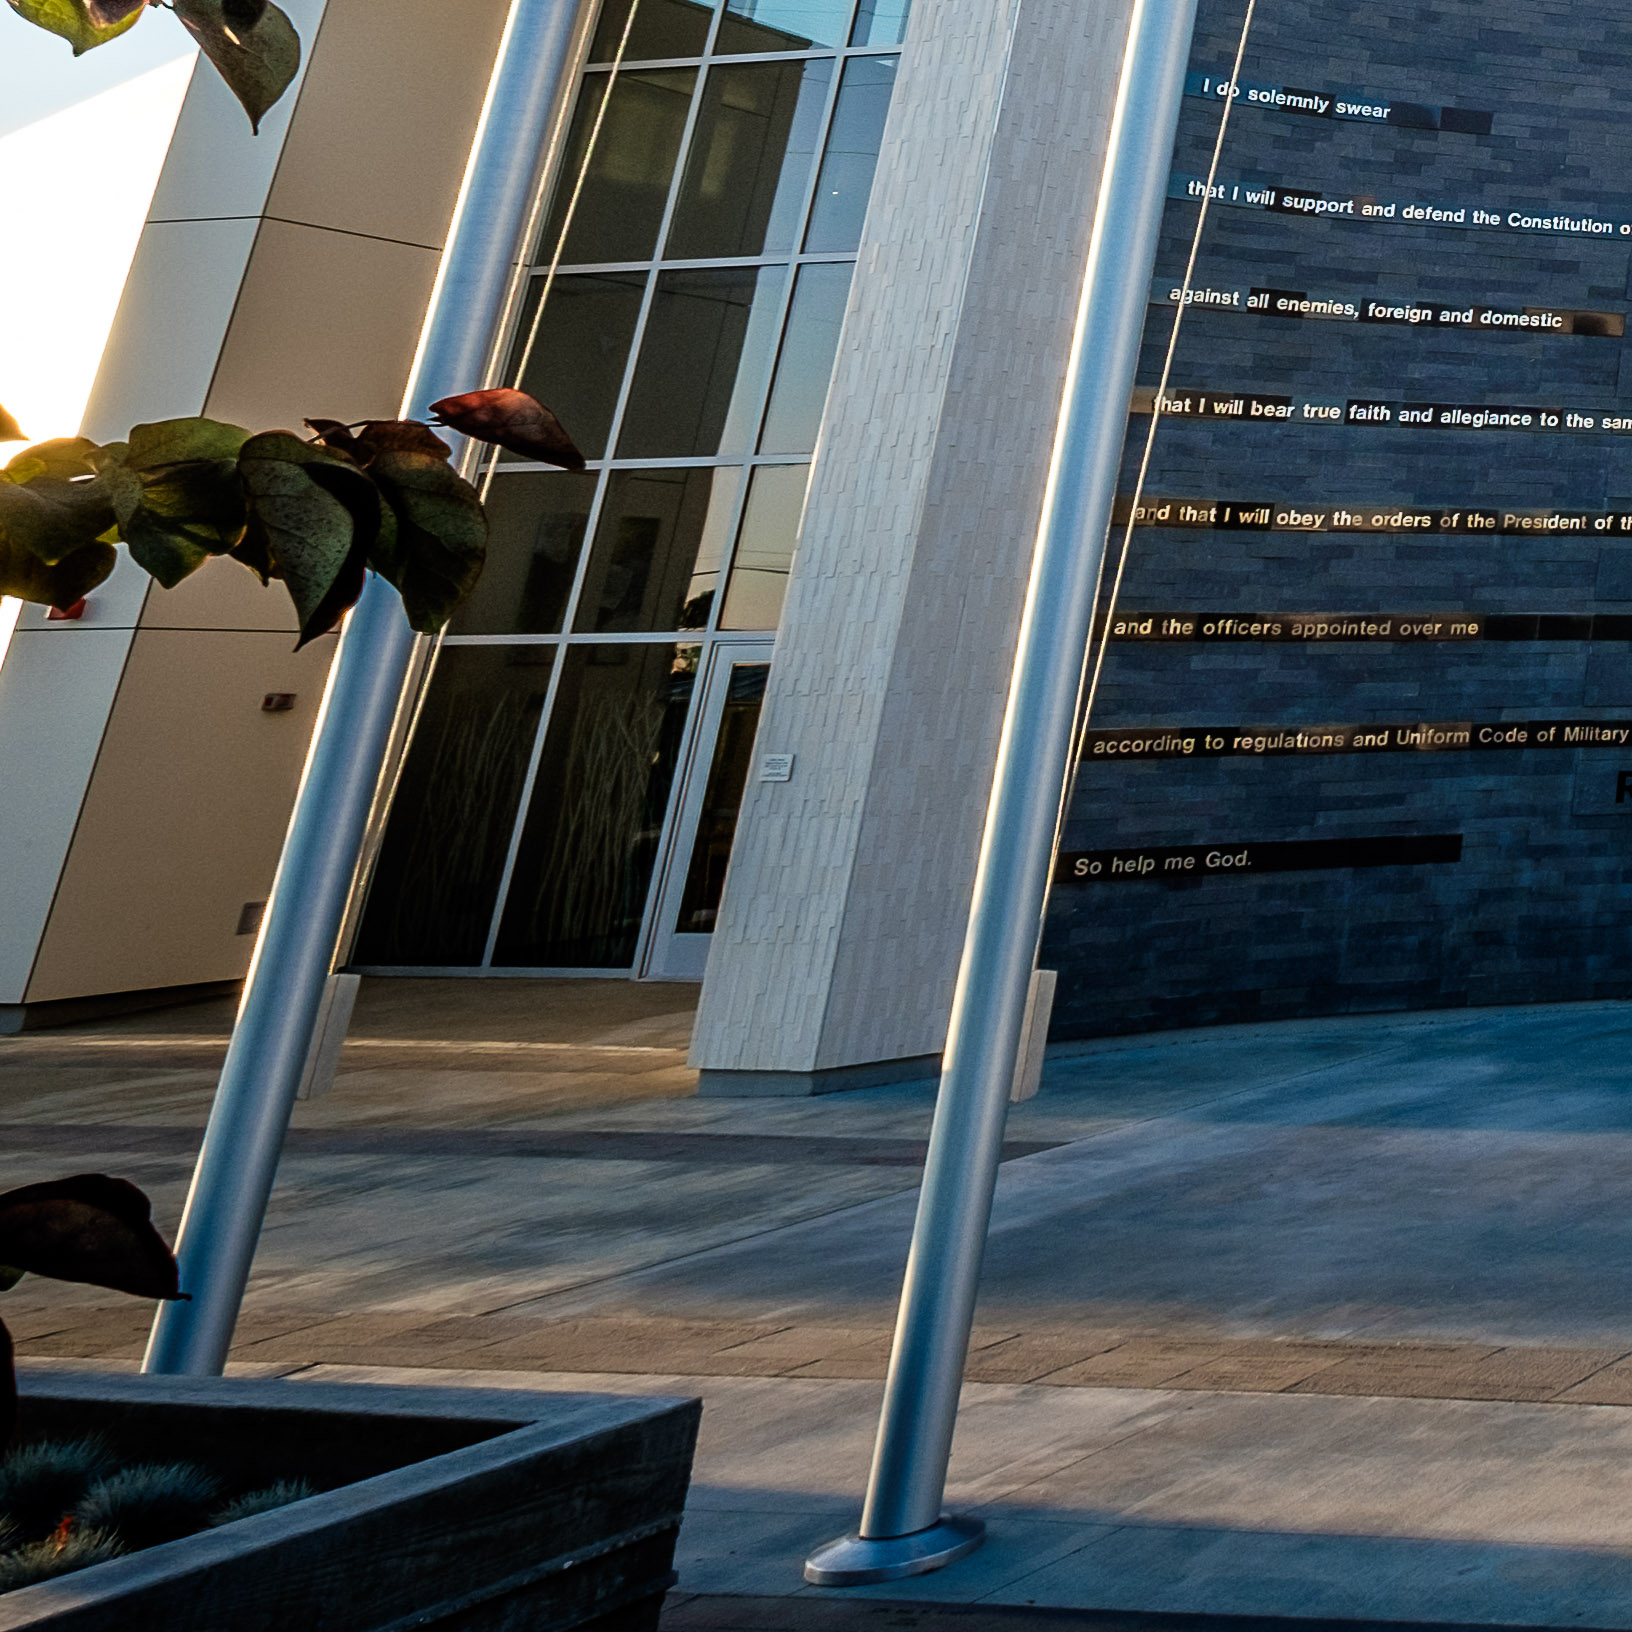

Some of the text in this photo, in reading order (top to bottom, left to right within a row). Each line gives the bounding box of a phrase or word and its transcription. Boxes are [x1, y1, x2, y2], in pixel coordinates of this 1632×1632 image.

[1202, 78, 1391, 118] I do solemnly swear
[1189, 179, 1226, 199] that
[1232, 185, 1239, 201] I
[1246, 189, 1275, 205] will
[1282, 195, 1354, 214] support
[1362, 203, 1395, 218] and
[1402, 204, 1465, 223] defend
[1473, 209, 1500, 225] the
[1508, 212, 1612, 233] Constitution
[1170, 285, 1562, 328] against all enemies, foreign and domestic
[1198, 397, 1206, 413] I
[1214, 399, 1243, 415] will
[1251, 400, 1295, 417] bear
[1303, 403, 1341, 419] true
[1350, 404, 1390, 421] faith
[1399, 407, 1433, 423] and
[1441, 409, 1532, 428] allegiance
[1540, 412, 1558, 427] to
[1566, 412, 1594, 429] the
[1134, 502, 1171, 522] and
[1180, 505, 1217, 523] that
[1223, 507, 1231, 522] I
[1239, 508, 1270, 524] will
[1277, 509, 1326, 529] obey
[1333, 510, 1362, 526] the
[1372, 511, 1431, 528] orders
[1440, 512, 1460, 528] of
[1467, 512, 1495, 529] the
[1504, 513, 1586, 530] President
[1595, 515, 1613, 529] of
[1113, 616, 1478, 639] and the officers appointed over me
[1094, 732, 1196, 755] according
[1205, 734, 1224, 750] to
[1233, 730, 1344, 754] regulations
[1353, 730, 1389, 747] and
[1397, 726, 1471, 746] Uniform
[1479, 726, 1528, 744] Code
[1537, 726, 1556, 742] of
[1564, 726, 1629, 743] Military
[1074, 850, 1251, 876] So help me God.
